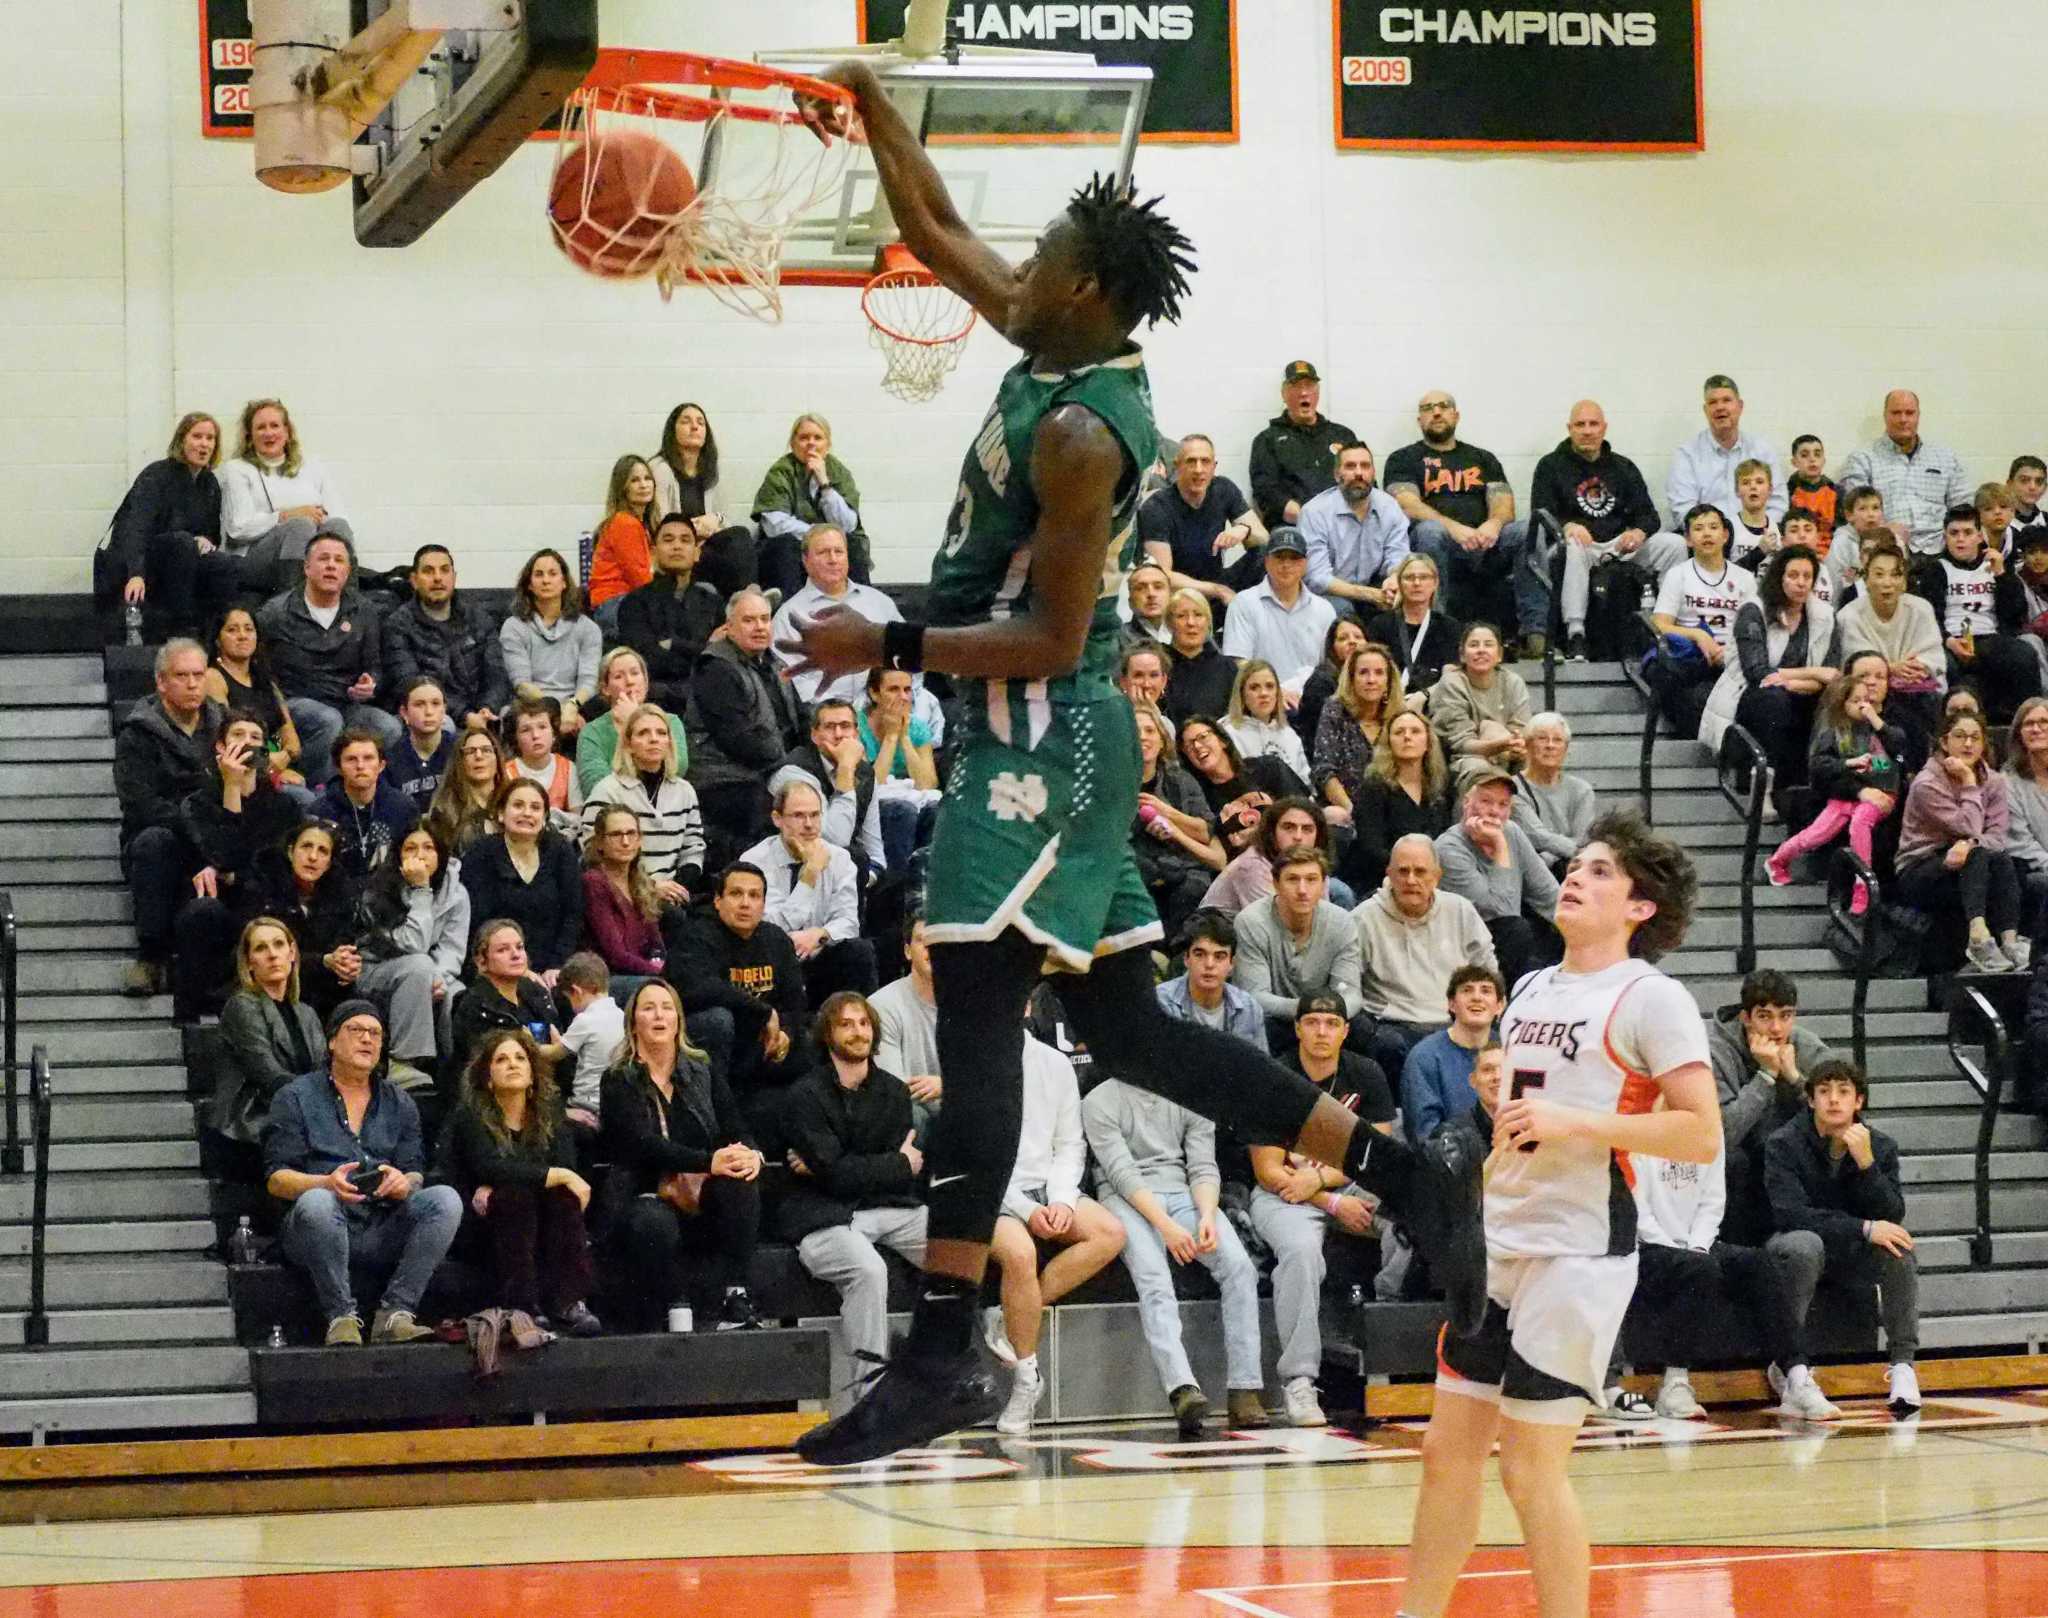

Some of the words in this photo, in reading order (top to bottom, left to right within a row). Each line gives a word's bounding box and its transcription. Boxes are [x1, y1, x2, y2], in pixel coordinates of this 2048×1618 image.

[904, 4, 1194, 40] HAMPIONS
[1379, 8, 1657, 46] CHAMPIONS
[1348, 60, 1407, 82] 2009
[1424, 466, 1484, 496] LAIR
[1505, 1017, 1588, 1062] TIGERS
